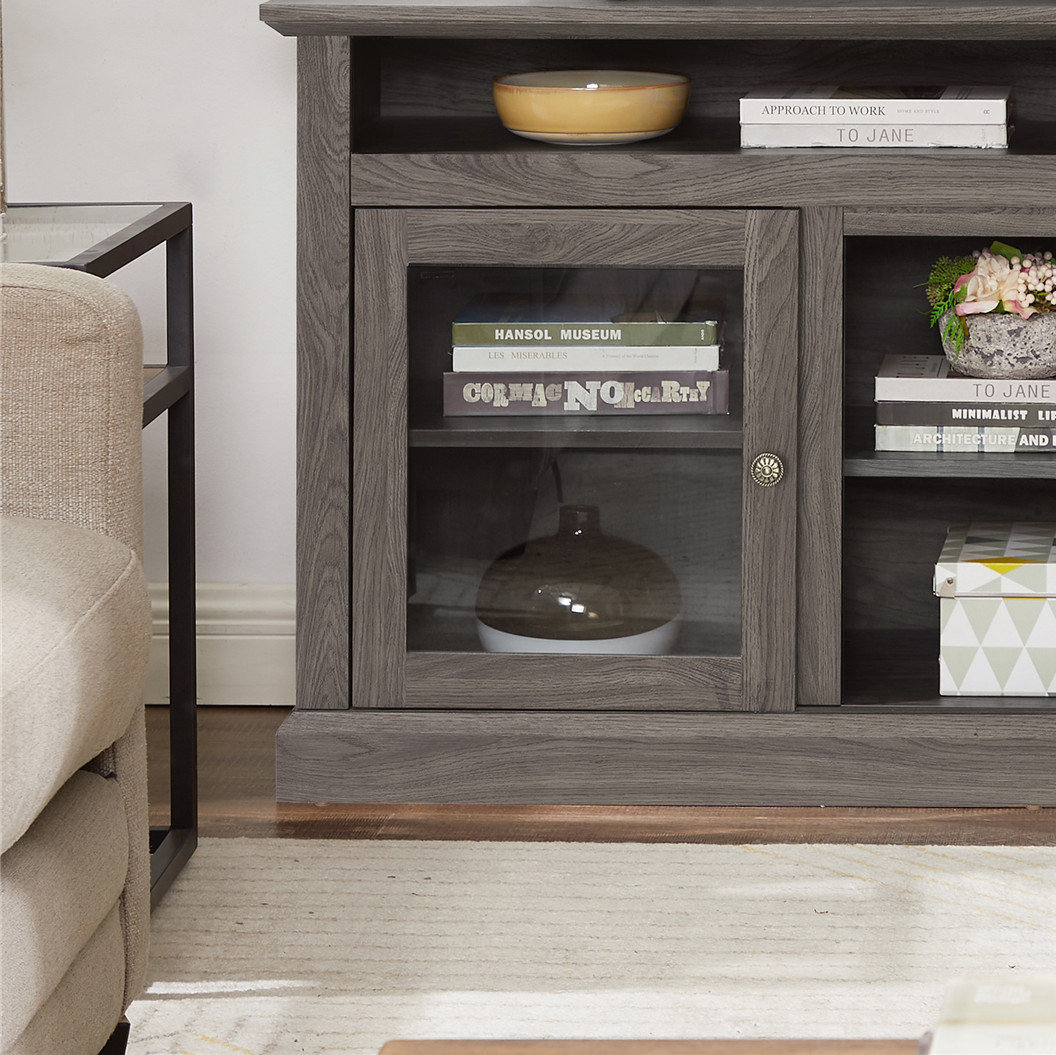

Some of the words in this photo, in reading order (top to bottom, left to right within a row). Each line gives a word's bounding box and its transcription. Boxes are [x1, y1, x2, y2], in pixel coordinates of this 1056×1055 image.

[761, 105, 827, 116] APPROACH
[828, 105, 846, 116] TO
[848, 105, 886, 116] WORK
[836, 128, 859, 142] TO
[866, 128, 914, 142] JANE
[495, 329, 552, 340] HANSOL
[560, 329, 622, 340] MUSEUM
[488, 352, 505, 360] LES
[511, 352, 568, 360] MISERABLES
[462, 382, 563, 407] CORMAC
[563, 380, 625, 411] NO
[973, 383, 995, 397] TO
[1003, 384, 1051, 399] JANE
[952, 408, 1028, 421] MINIMALIST
[913, 432, 1016, 446] ARCHITECTURE
[1018, 434, 1049, 446] AND
